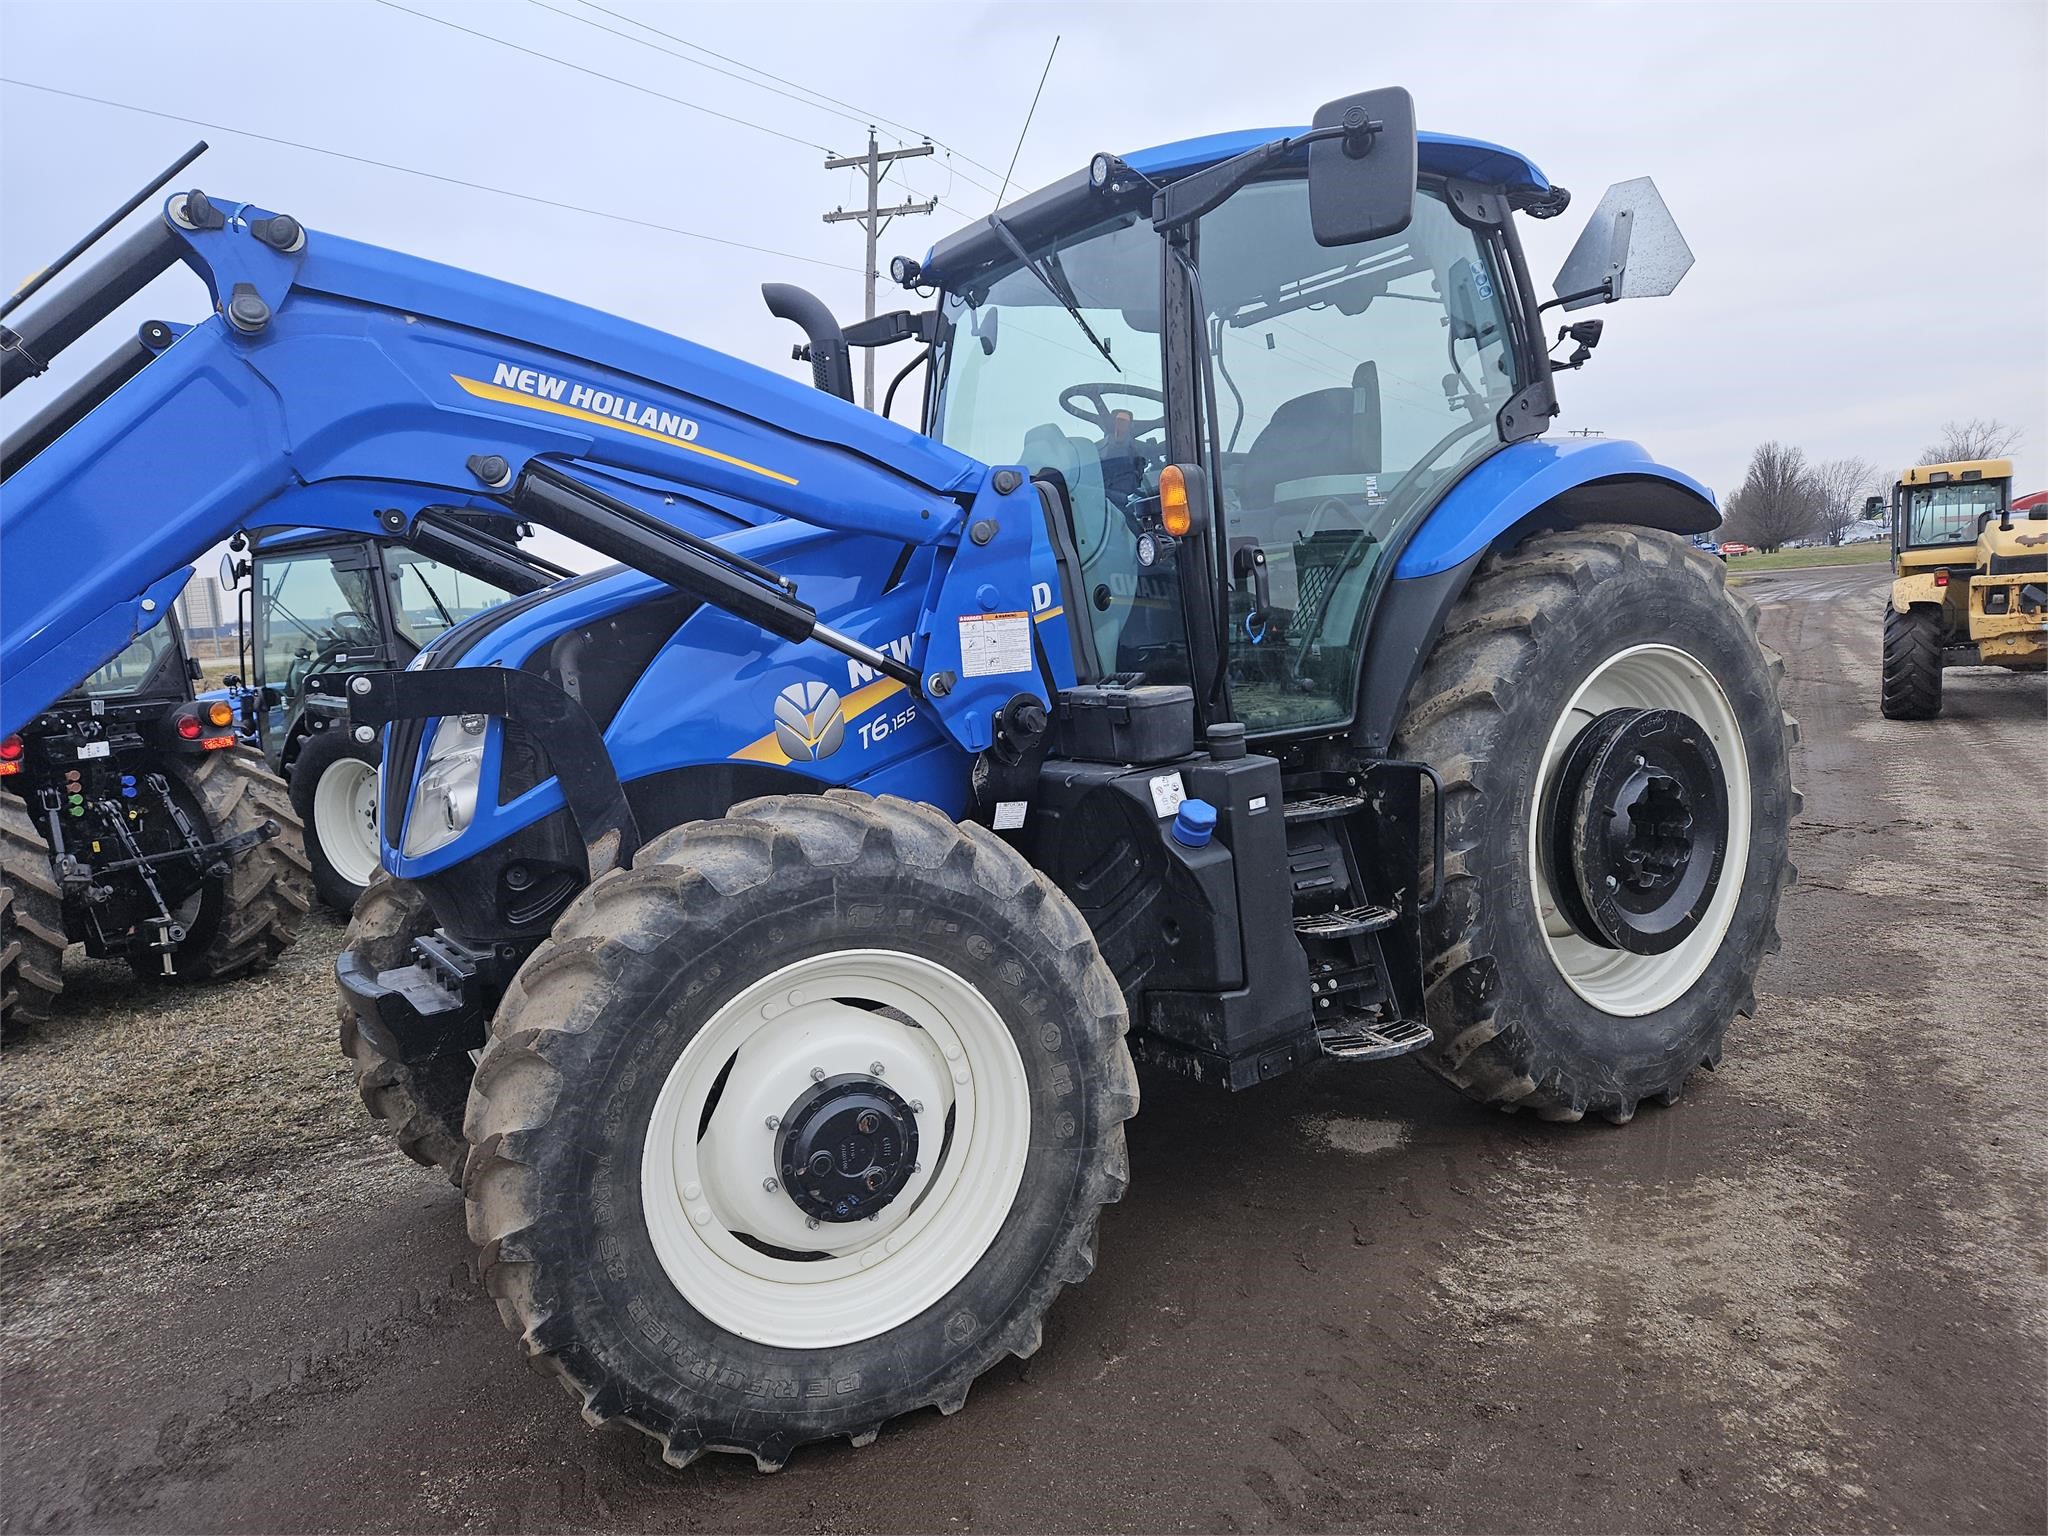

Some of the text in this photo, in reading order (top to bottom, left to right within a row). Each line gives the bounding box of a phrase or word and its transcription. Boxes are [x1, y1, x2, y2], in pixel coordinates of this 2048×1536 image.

[493, 363, 699, 441] NEW HOLLAND
[1366, 475, 1378, 498] PLM
[592, 1154, 614, 1225] EXTRA
[626, 1295, 861, 1399] PERFORMER
